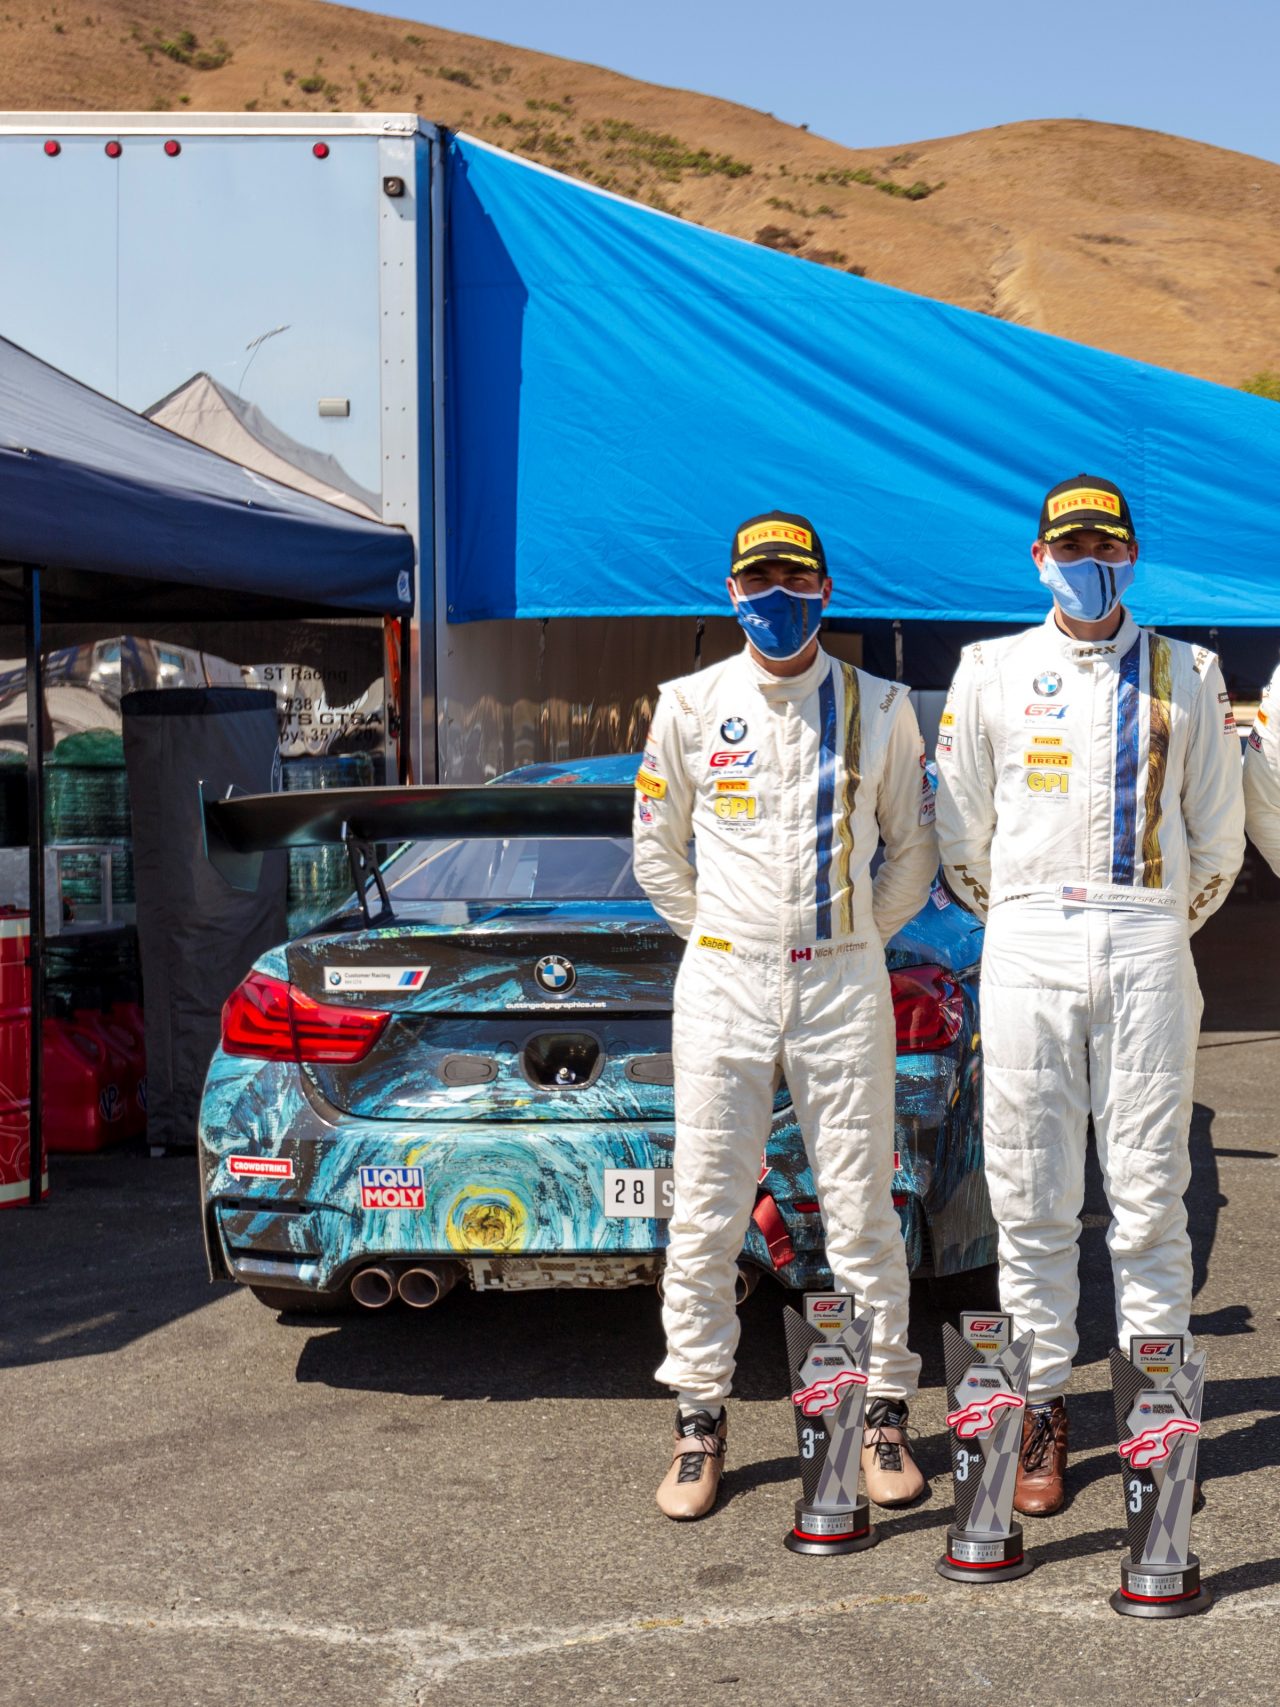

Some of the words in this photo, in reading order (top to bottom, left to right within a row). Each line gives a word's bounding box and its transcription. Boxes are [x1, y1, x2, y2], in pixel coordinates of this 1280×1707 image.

[1053, 493, 1115, 514] PIRELLI
[744, 525, 806, 545] PIRELLI
[1078, 644, 1116, 657] HRX
[263, 667, 285, 680] ST
[291, 667, 348, 684] Racing
[1024, 704, 1070, 719] GT4
[709, 750, 758, 767] GT4
[1027, 754, 1068, 765] PIRELLI
[1027, 772, 1069, 793] GPI
[715, 797, 756, 819] GPI
[701, 937, 729, 951] Sabelt
[815, 948, 833, 958] Nick
[372, 971, 391, 980] Racing
[505, 1001, 607, 1010] cuttingedgegraphics.net
[233, 1162, 288, 1174] CROWDSTRIKE
[364, 1169, 420, 1188] LIQUI
[364, 1189, 422, 1207] MOLY
[615, 1178, 645, 1205] 28
[813, 1300, 846, 1313] GT4
[970, 1320, 1003, 1333] GT4
[1139, 1343, 1175, 1356] GT4
[802, 1428, 825, 1459] 3rd
[956, 1450, 980, 1481] 3rd
[1129, 1480, 1153, 1513] 3rd
